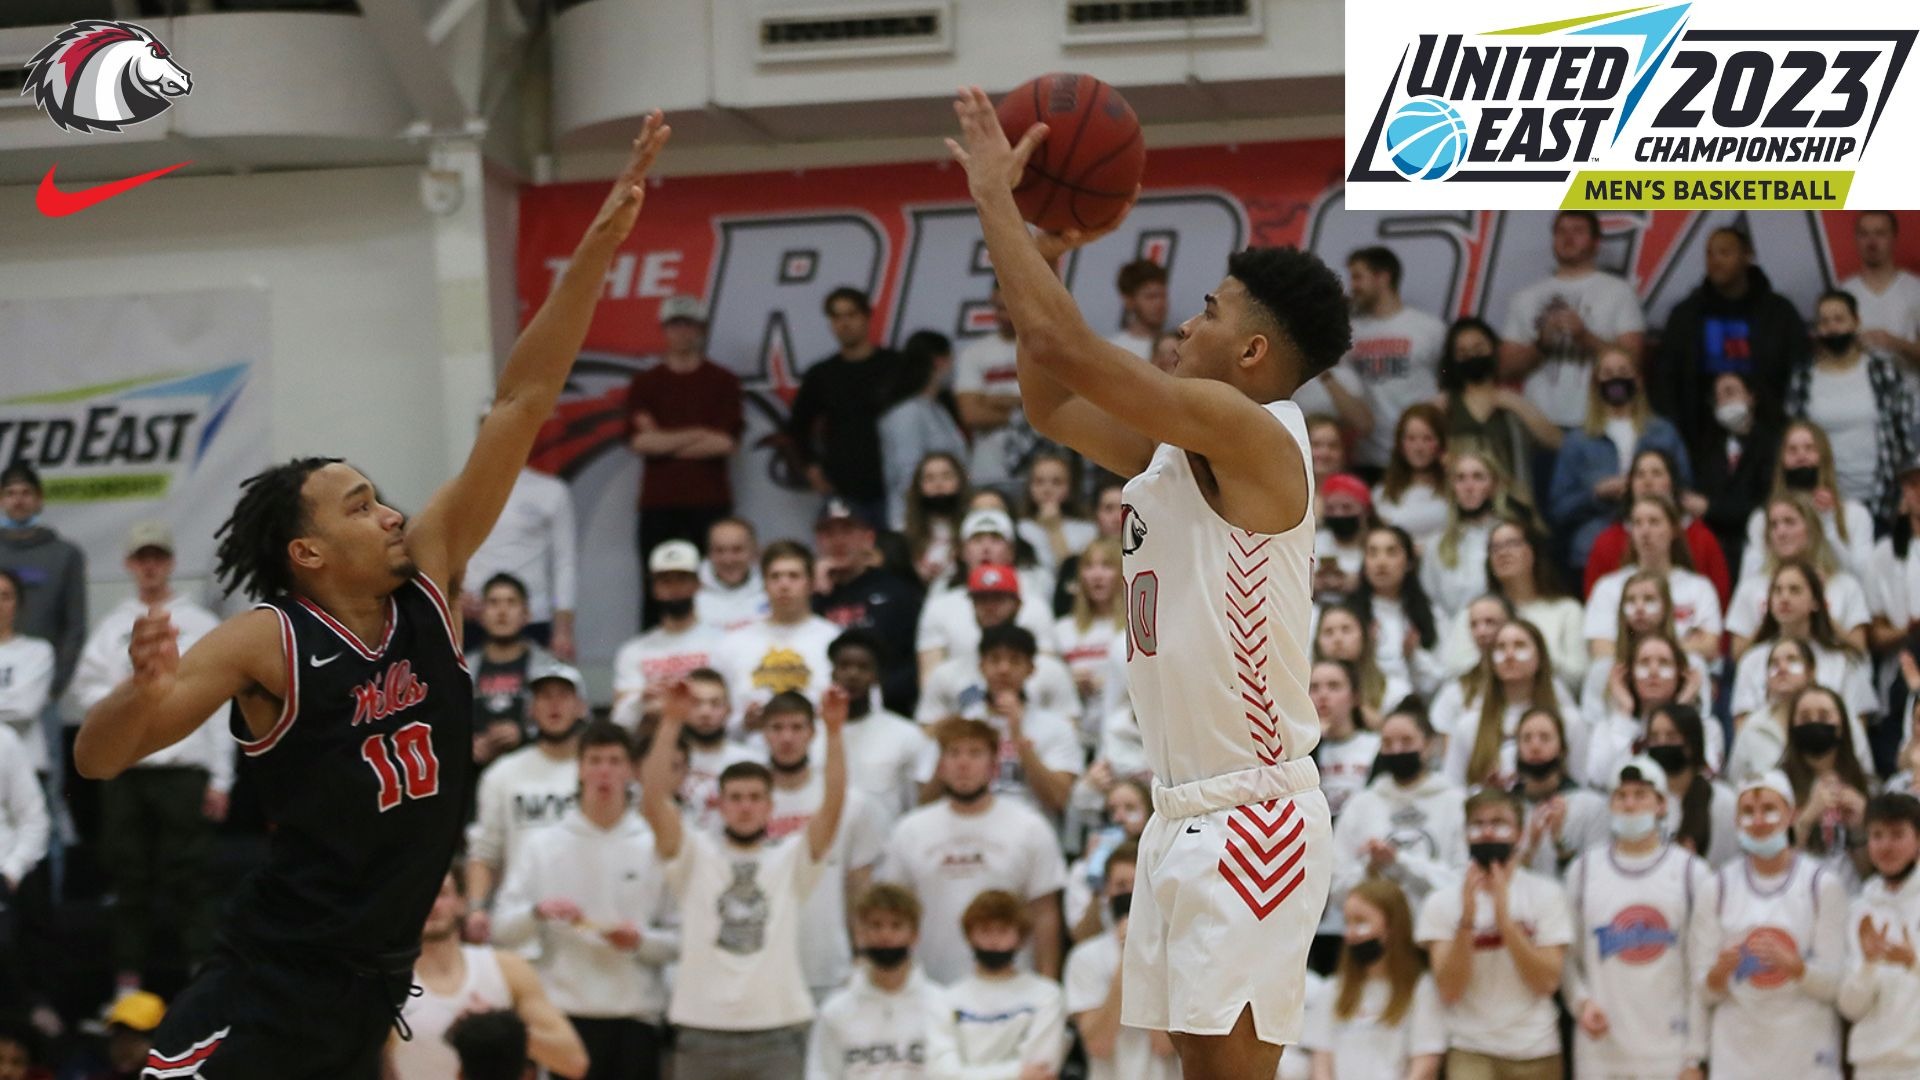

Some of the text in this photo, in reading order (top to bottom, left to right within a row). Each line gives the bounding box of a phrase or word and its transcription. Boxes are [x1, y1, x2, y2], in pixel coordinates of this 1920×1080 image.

[75, 404, 199, 466] EAST
[350, 659, 429, 726] Wells
[361, 721, 439, 812] 10
